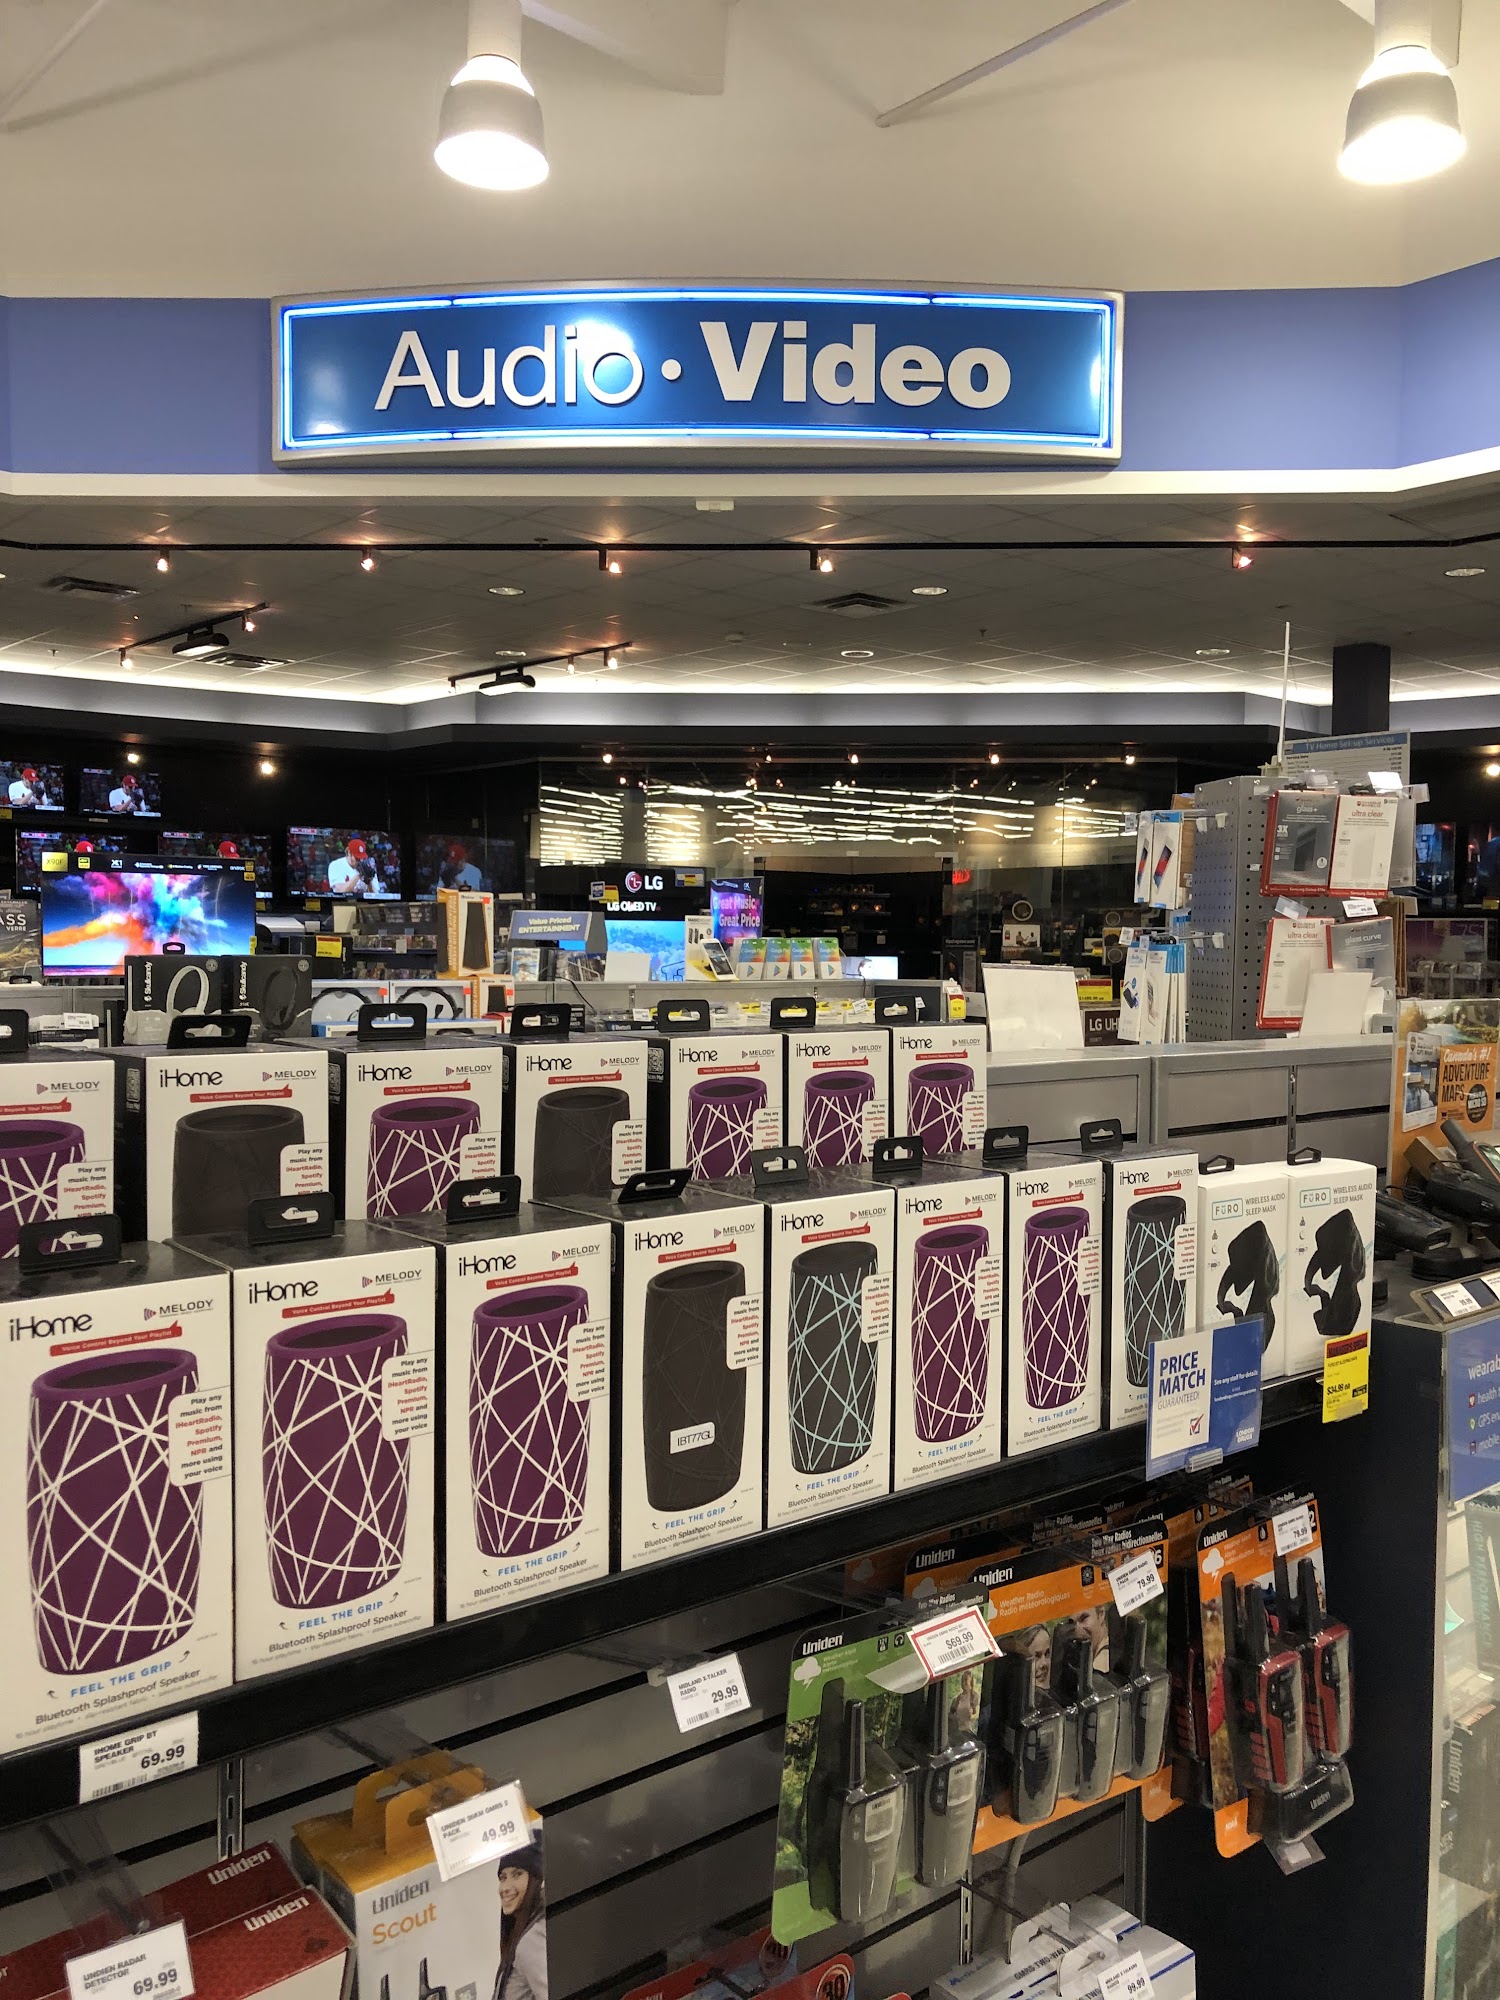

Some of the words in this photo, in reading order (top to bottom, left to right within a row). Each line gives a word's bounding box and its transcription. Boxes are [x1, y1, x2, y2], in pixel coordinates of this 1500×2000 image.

[374, 322, 645, 411] Audio
[699, 321, 1012, 409] Video
[46, 858, 64, 866] X90F
[645, 875, 663, 890] LG
[607, 902, 619, 911] LG
[645, 902, 657, 911] TV
[713, 896, 733, 910] Great
[519, 924, 580, 934] ENTERTAINMENT
[529, 918, 547, 926] Value
[549, 916, 572, 924] Priced
[719, 914, 739, 927] Great
[740, 914, 760, 927] Price
[1090, 1019, 1102, 1031] LG
[1105, 1018, 1119, 1031] UH
[796, 1044, 831, 1057] iHome
[900, 1036, 933, 1049] iHome
[526, 1056, 572, 1072] iHome
[609, 1057, 640, 1065] MELODY
[679, 1048, 718, 1063] iHome
[749, 1049, 775, 1057] MELODY
[1444, 1048, 1477, 1063] Canada's
[159, 1070, 223, 1088] iHome
[274, 1070, 317, 1080] MELODY
[358, 1064, 412, 1082] iHome
[456, 1065, 492, 1074] MELODY
[1443, 1063, 1490, 1082] ADVENTURE
[51, 1081, 100, 1092] MELODY
[1442, 1084, 1465, 1102] MAPS
[1120, 1171, 1150, 1185] iHome
[1173, 1168, 1194, 1177] MELODY
[1016, 1181, 1049, 1197] iHome
[1074, 1177, 1097, 1186] MELODY
[1333, 1185, 1358, 1194] WIRELESS
[1358, 1183, 1373, 1191] AUDIO
[905, 1198, 943, 1214] iHome
[971, 1193, 997, 1203] MELODY
[1245, 1196, 1270, 1205] WIRELESS
[1271, 1193, 1286, 1201] AUDIO
[1333, 1197, 1349, 1205] SLEEP
[1349, 1194, 1363, 1202] MASK
[1246, 1208, 1261, 1216] SLEEP
[1262, 1205, 1277, 1213] MASK
[781, 1213, 824, 1232] iHome
[858, 1207, 887, 1216] MELODY
[635, 1231, 684, 1251] iHome
[723, 1223, 756, 1235] MELODY
[458, 1254, 517, 1277] iHome
[562, 1244, 600, 1257] MELODY
[249, 1279, 319, 1305] iHome
[375, 1269, 422, 1282] MELODY
[10, 1313, 93, 1342] iHome
[159, 1299, 214, 1315] MELODY
[82, 1340, 107, 1350] Control
[108, 1336, 132, 1345] Beyond
[1160, 1350, 1198, 1377] PRICE
[1158, 1369, 1206, 1397] MATCH
[191, 1396, 207, 1405] Play
[208, 1394, 222, 1403] any
[1158, 1391, 1200, 1410] GUARANTEED!
[1478, 1387, 1497, 1404] health
[180, 1408, 203, 1417] music
[204, 1404, 222, 1413] from
[1478, 1412, 1491, 1427] GPS
[195, 1424, 222, 1436] Spotify
[1236, 1427, 1255, 1438] LONDON
[187, 1435, 223, 1447] Premium,
[191, 1446, 207, 1456] NPR
[209, 1444, 223, 1452] and
[181, 1458, 201, 1469] more
[203, 1455, 223, 1464] using
[184, 1468, 202, 1479] your
[203, 1465, 223, 1474] voice
[1114, 1530, 1132, 1542] Radios
[1122, 1532, 1163, 1549] bidirectionnelles
[1204, 1529, 1228, 1547] Uniden
[916, 1548, 955, 1569] Uniden
[1137, 1574, 1155, 1590] 79.99
[999, 1595, 1025, 1608] Weather
[1026, 1590, 1045, 1600] Radio
[298, 1615, 327, 1630] FEEL
[331, 1608, 354, 1622] THE
[357, 1601, 384, 1615] GRIP
[999, 1604, 1017, 1618] Radio
[268, 1632, 315, 1653] Bluetooth
[317, 1617, 370, 1640] Splashproof
[372, 1609, 408, 1627] Speaker
[802, 1633, 844, 1656] Uniden
[945, 1631, 974, 1650] $69.99
[70, 1681, 105, 1698] FEEL
[109, 1672, 136, 1687] THE
[140, 1661, 172, 1678] GRIP
[679, 1678, 702, 1690] MIDLAND
[35, 1701, 90, 1725] Bluetooth
[93, 1681, 157, 1708] Splashproof
[159, 1669, 201, 1688] Speaker
[680, 1686, 697, 1696] RADIO
[711, 1684, 739, 1703] 29.99
[94, 1738, 123, 1755] IHOME
[124, 1734, 145, 1747] GRIP
[146, 1730, 158, 1739] BT
[94, 1746, 134, 1764] SPEAKER
[141, 1744, 185, 1769] 69.99
[441, 1818, 465, 1832] UNIDEN
[443, 1828, 461, 1839] PACK
[482, 1821, 515, 1842] 49.99
[207, 1849, 272, 1886] Uniden
[372, 1878, 430, 1916] Uniden
[244, 1896, 311, 1932] Uniden
[372, 1903, 437, 1945] Scout
[117, 1954, 147, 1969] RADAR
[1013, 1964, 1036, 1980] GMRS
[1034, 1948, 1067, 1972] TWO-WAY
[85, 1968, 129, 1990] DETECTOR
[133, 1968, 178, 1995] 69.99
[1126, 1977, 1146, 1995] 99.99
